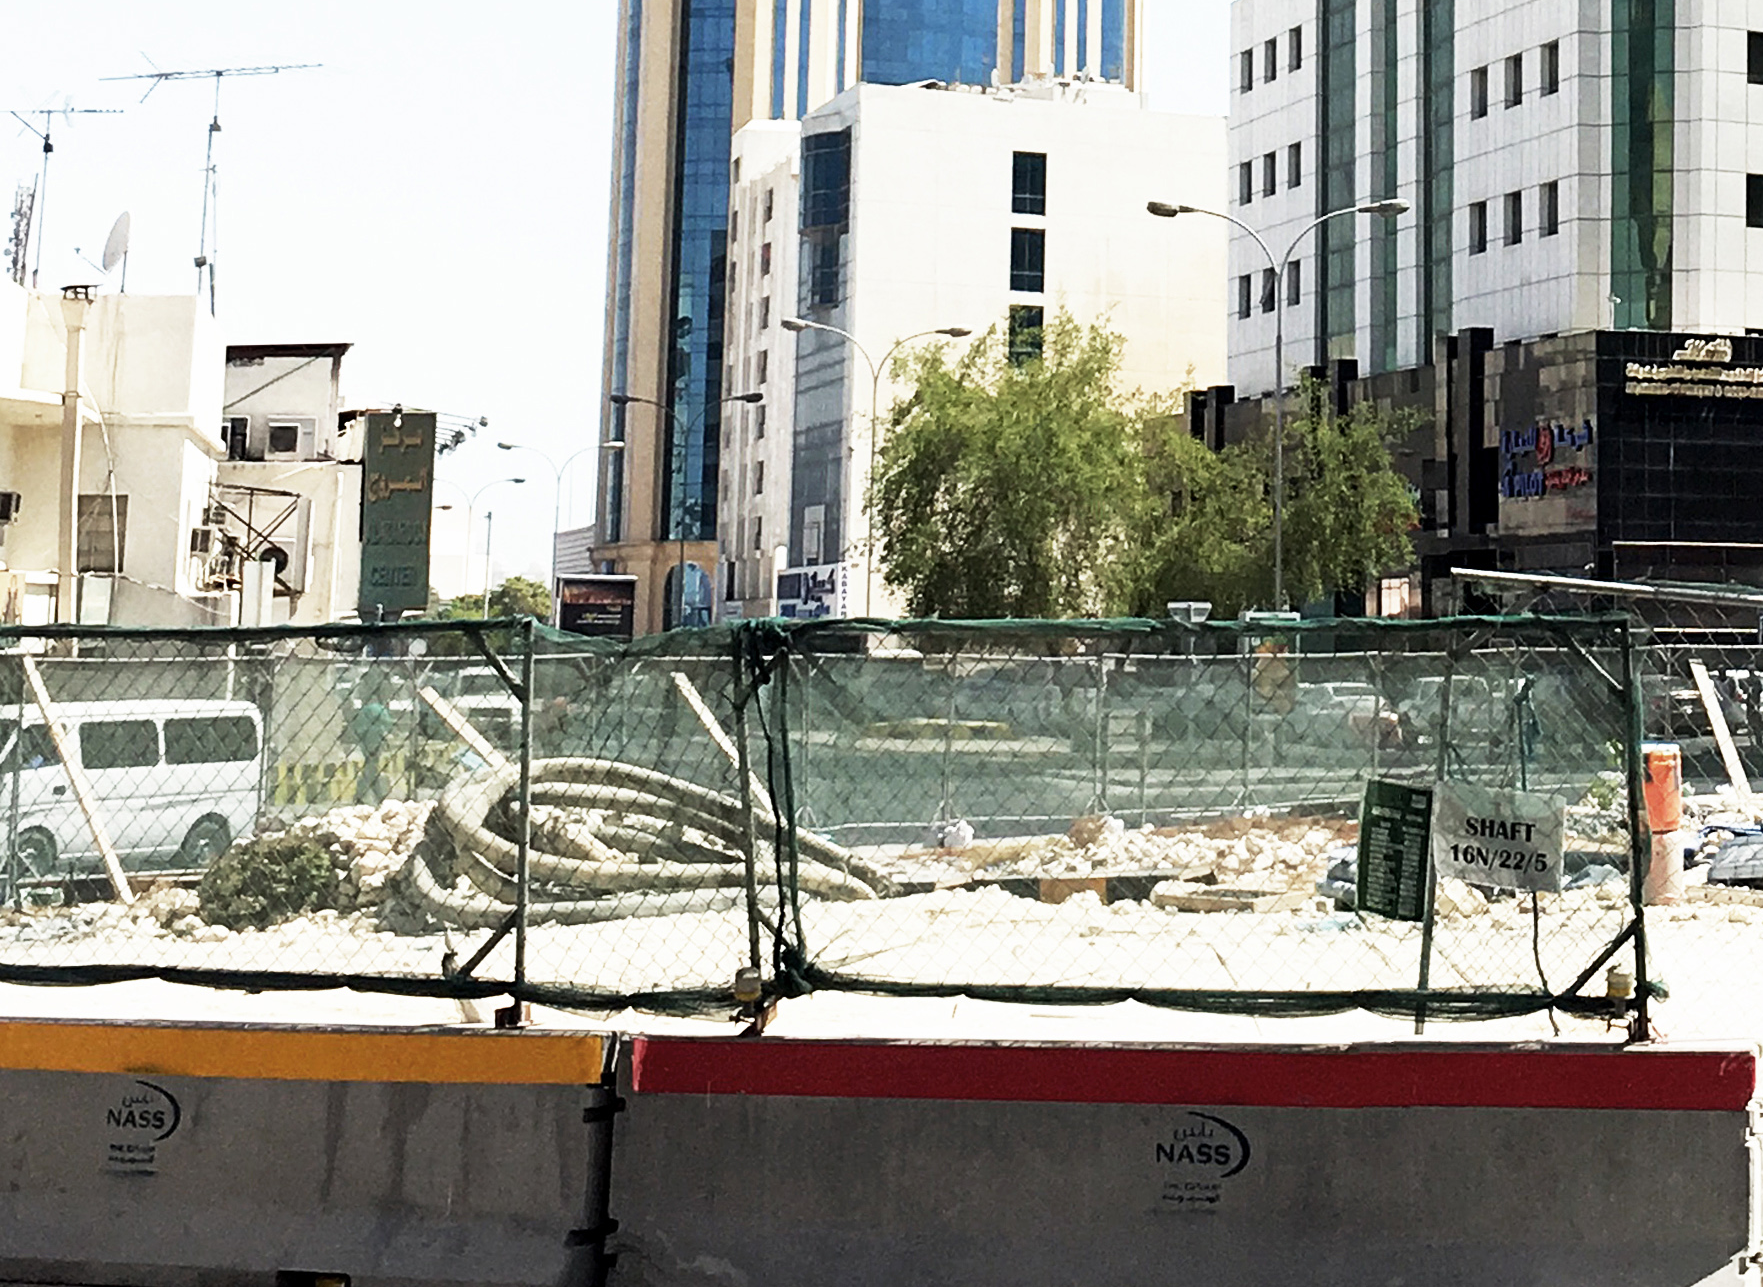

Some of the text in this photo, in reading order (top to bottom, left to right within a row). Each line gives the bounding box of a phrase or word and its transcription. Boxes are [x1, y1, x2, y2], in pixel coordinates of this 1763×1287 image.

[1465, 817, 1536, 842] SHAFT
[1450, 843, 1548, 874] 16N/22/5
[107, 1108, 165, 1129] NASS
[1156, 1143, 1230, 1165] NASS
